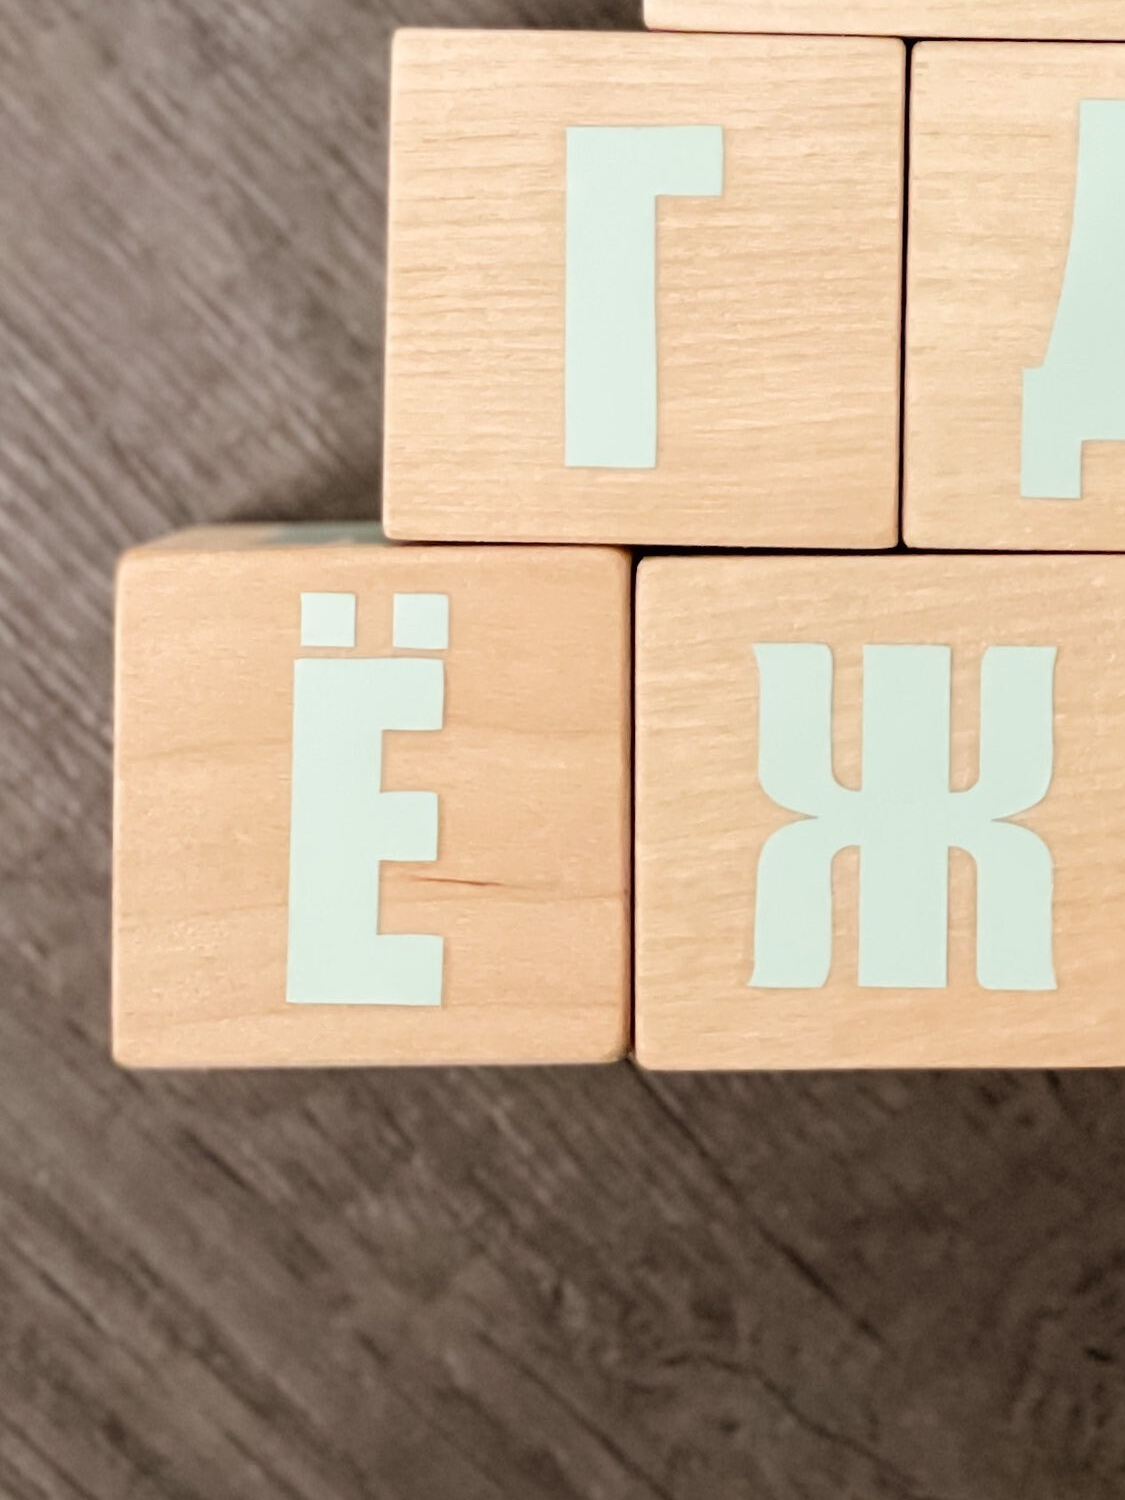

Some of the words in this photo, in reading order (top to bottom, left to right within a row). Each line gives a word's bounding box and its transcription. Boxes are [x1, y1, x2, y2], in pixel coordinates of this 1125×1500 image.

[563, 125, 725, 469] Г
[285, 591, 450, 1006] Ё
[751, 642, 1057, 991] Ж
